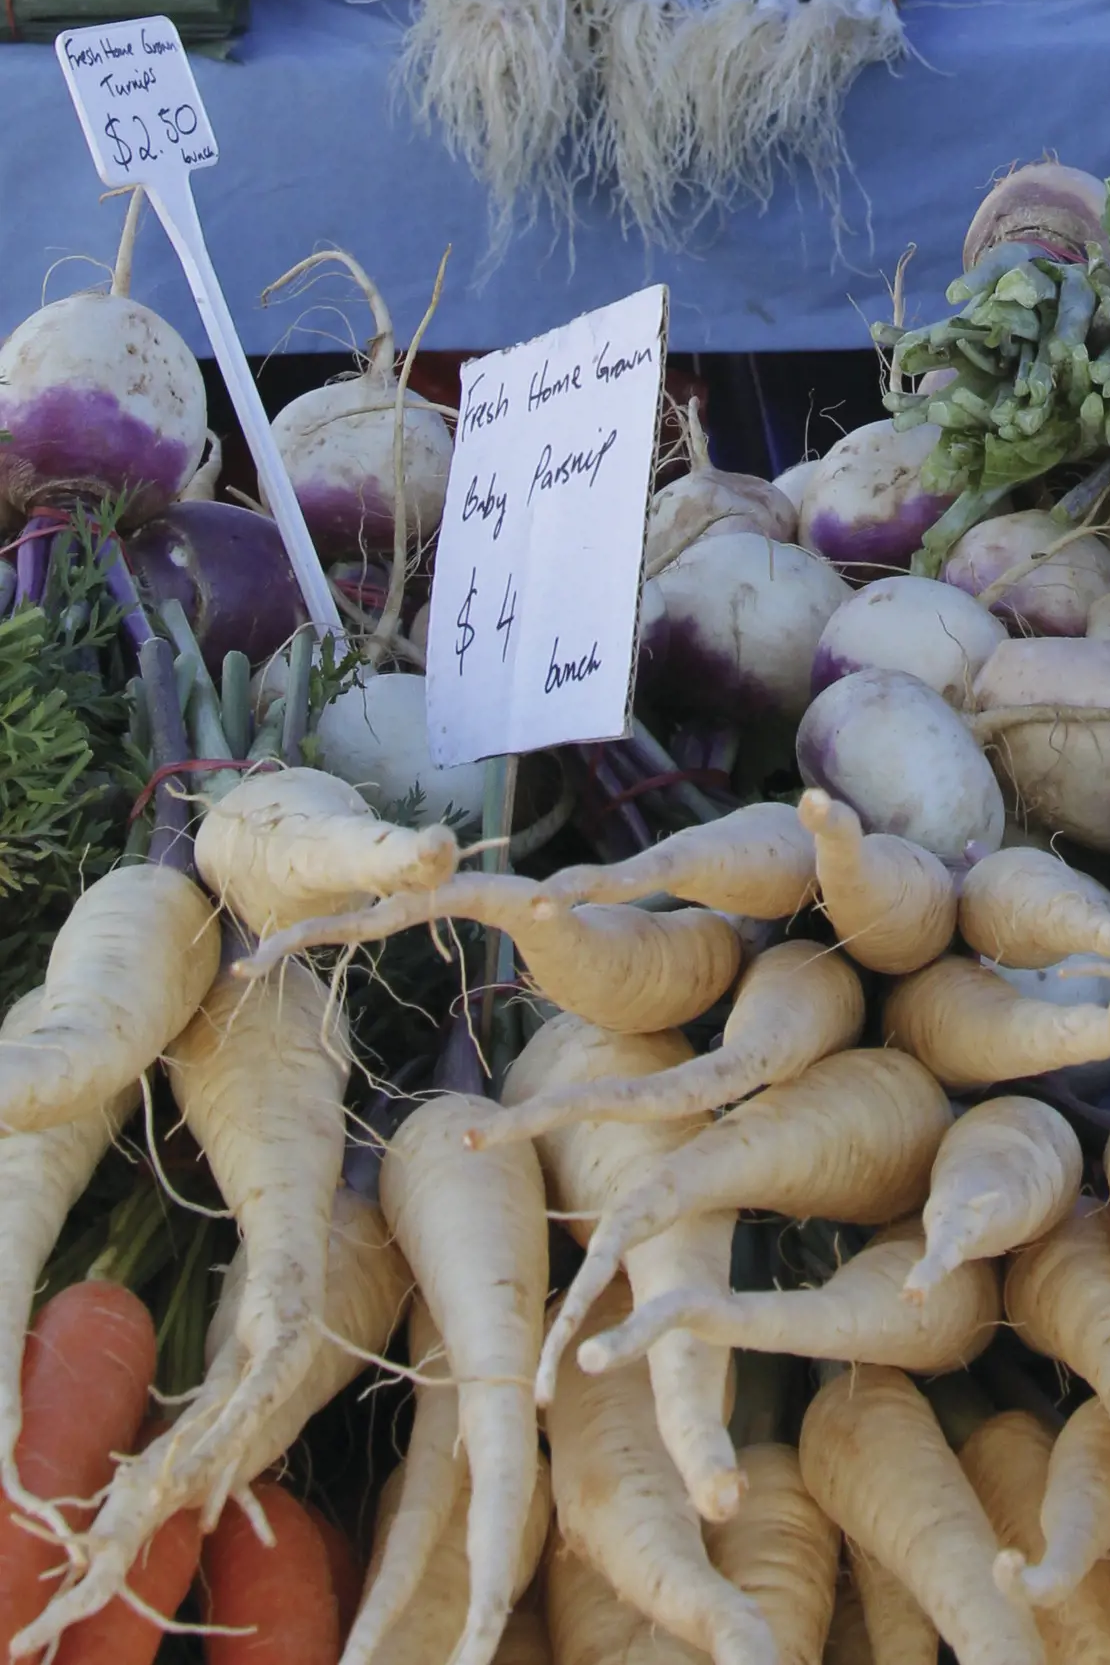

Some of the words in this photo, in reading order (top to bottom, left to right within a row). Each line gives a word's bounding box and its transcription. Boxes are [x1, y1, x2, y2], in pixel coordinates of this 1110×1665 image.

[65, 38, 103, 70] Fresh
[100, 38, 134, 59] Home
[141, 28, 178, 55] Grown
[100, 67, 157, 98] Turnips
[461, 372, 509, 443] Fresh
[527, 359, 582, 413] Home
[595, 341, 653, 384] Grown
[462, 472, 507, 541] Baby
[544, 636, 602, 694] bunch
